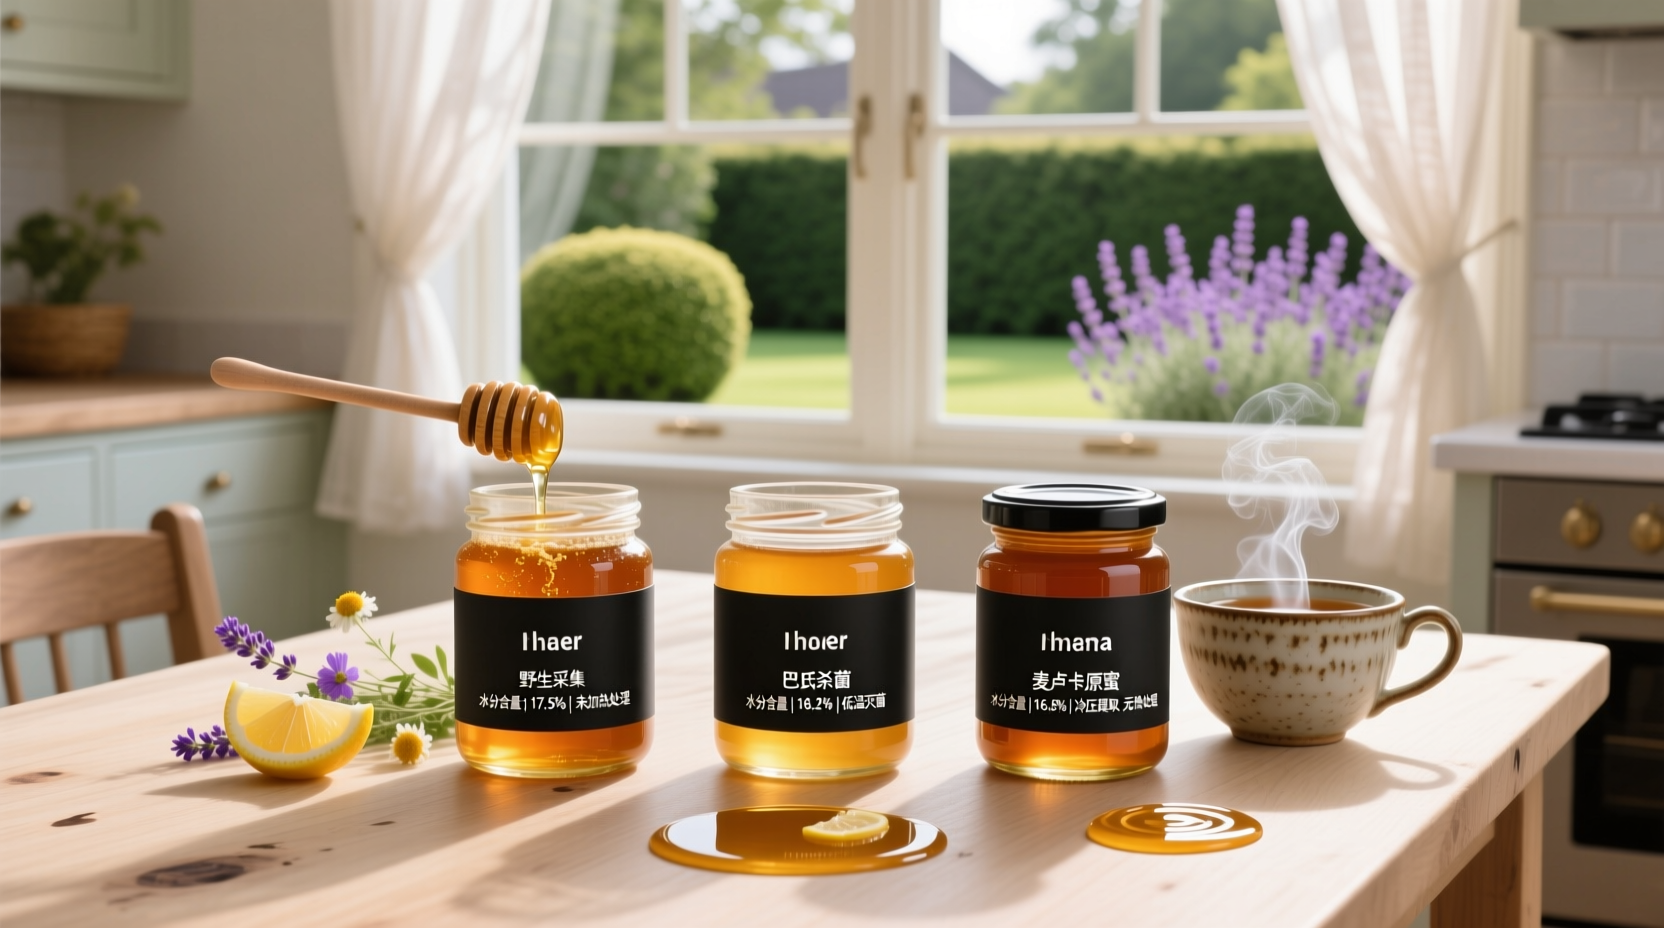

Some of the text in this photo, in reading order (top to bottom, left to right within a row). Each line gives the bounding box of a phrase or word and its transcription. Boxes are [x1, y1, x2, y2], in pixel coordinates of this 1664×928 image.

[519, 668, 586, 689] 野生采集
[782, 669, 852, 690] 巴氏杀菌
[1032, 670, 1121, 692] 麦卢卡原蜜
